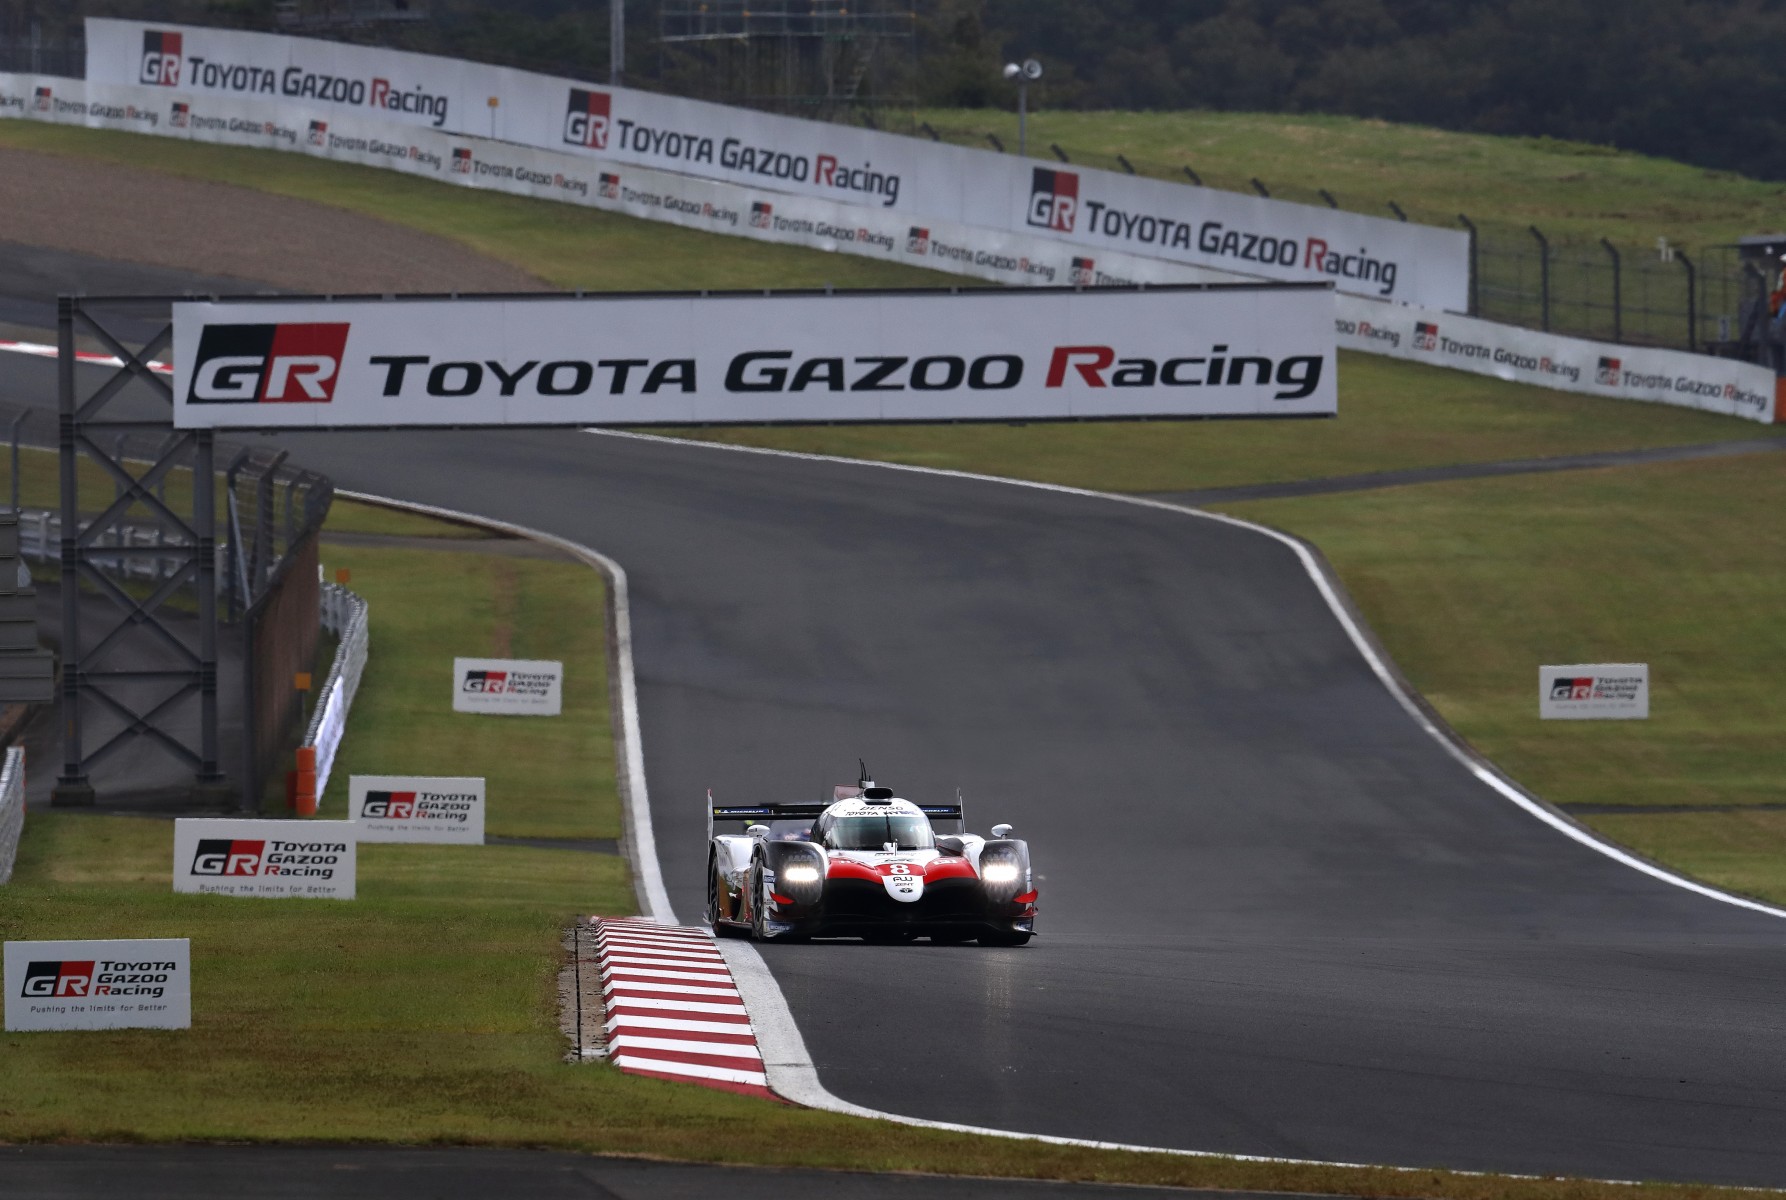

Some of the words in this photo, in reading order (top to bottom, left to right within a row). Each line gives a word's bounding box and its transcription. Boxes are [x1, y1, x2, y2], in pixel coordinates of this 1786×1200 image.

[188, 57, 276, 94] TOYOTA
[282, 67, 365, 105] GAZOO
[369, 79, 448, 126] Racing
[617, 119, 713, 164] TOYOTA
[720, 138, 808, 183] GAZOO
[814, 154, 900, 206] Racing
[1086, 201, 1191, 251] TOYOTA
[1199, 221, 1298, 267] GAZOO
[1304, 237, 1397, 295] Racing
[369, 355, 696, 397] TOYOTA
[724, 350, 1024, 392] GAZOO
[1045, 344, 1324, 400] Racing
[420, 792, 477, 802] TOYOTA
[418, 802, 470, 811] GAZOO
[416, 811, 467, 822] Racing
[271, 841, 346, 852] TOYOTA
[267, 853, 338, 865] GAZOO
[264, 865, 333, 880] Racing
[890, 864, 910, 875] 8
[100, 961, 176, 972] TOYOTA
[97, 973, 168, 984] GAZOO
[95, 984, 164, 998] Racing
[30, 1005, 66, 1014] Pushing
[89, 1004, 116, 1012] limits
[120, 1004, 134, 1012] for
[138, 1004, 168, 1012] Better
